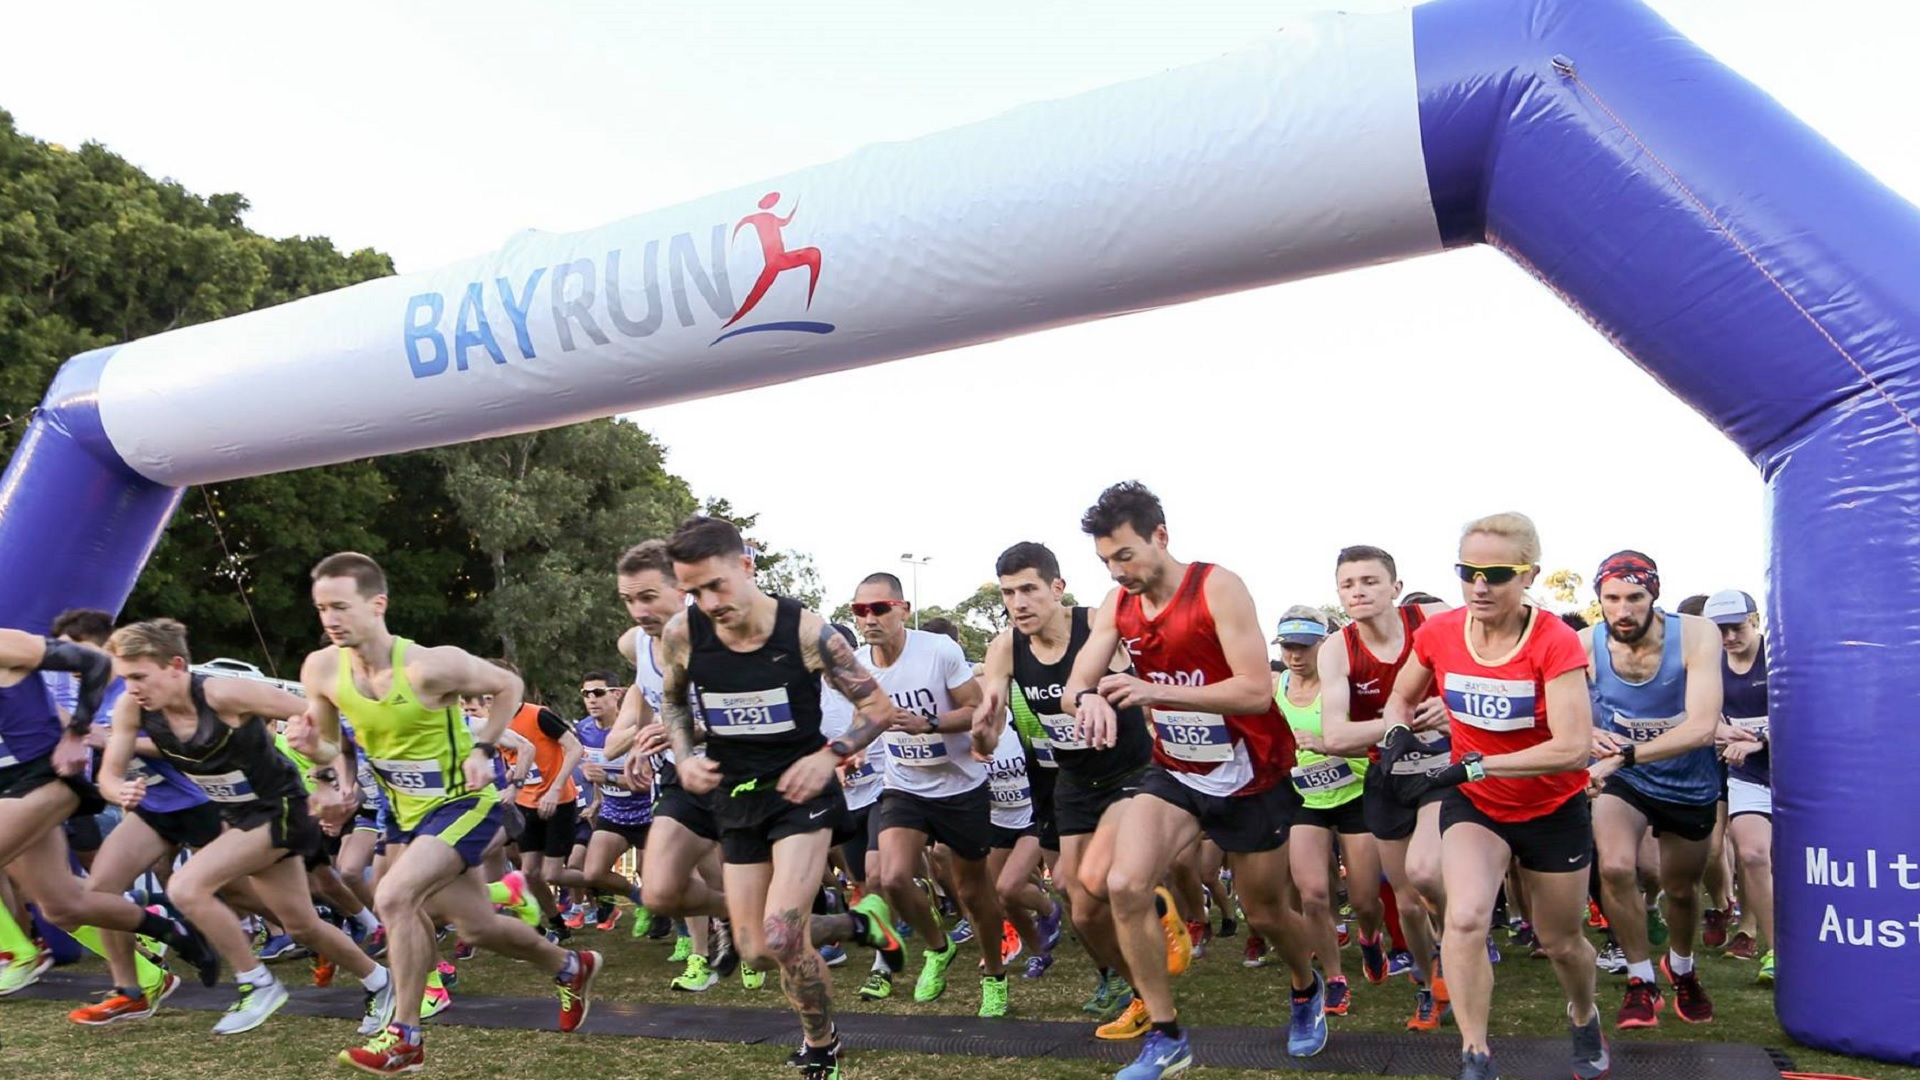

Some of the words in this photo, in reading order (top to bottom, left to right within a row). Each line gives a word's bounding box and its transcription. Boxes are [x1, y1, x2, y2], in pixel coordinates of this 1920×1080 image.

[403, 223, 737, 378] BAYRUN
[723, 706, 773, 726] 1291
[1463, 694, 1511, 719] 1169
[1166, 725, 1213, 744] 1362
[898, 745, 933, 759] 1575
[391, 772, 426, 788] 653
[1304, 768, 1340, 787] 1580
[993, 790, 1024, 802] 1003
